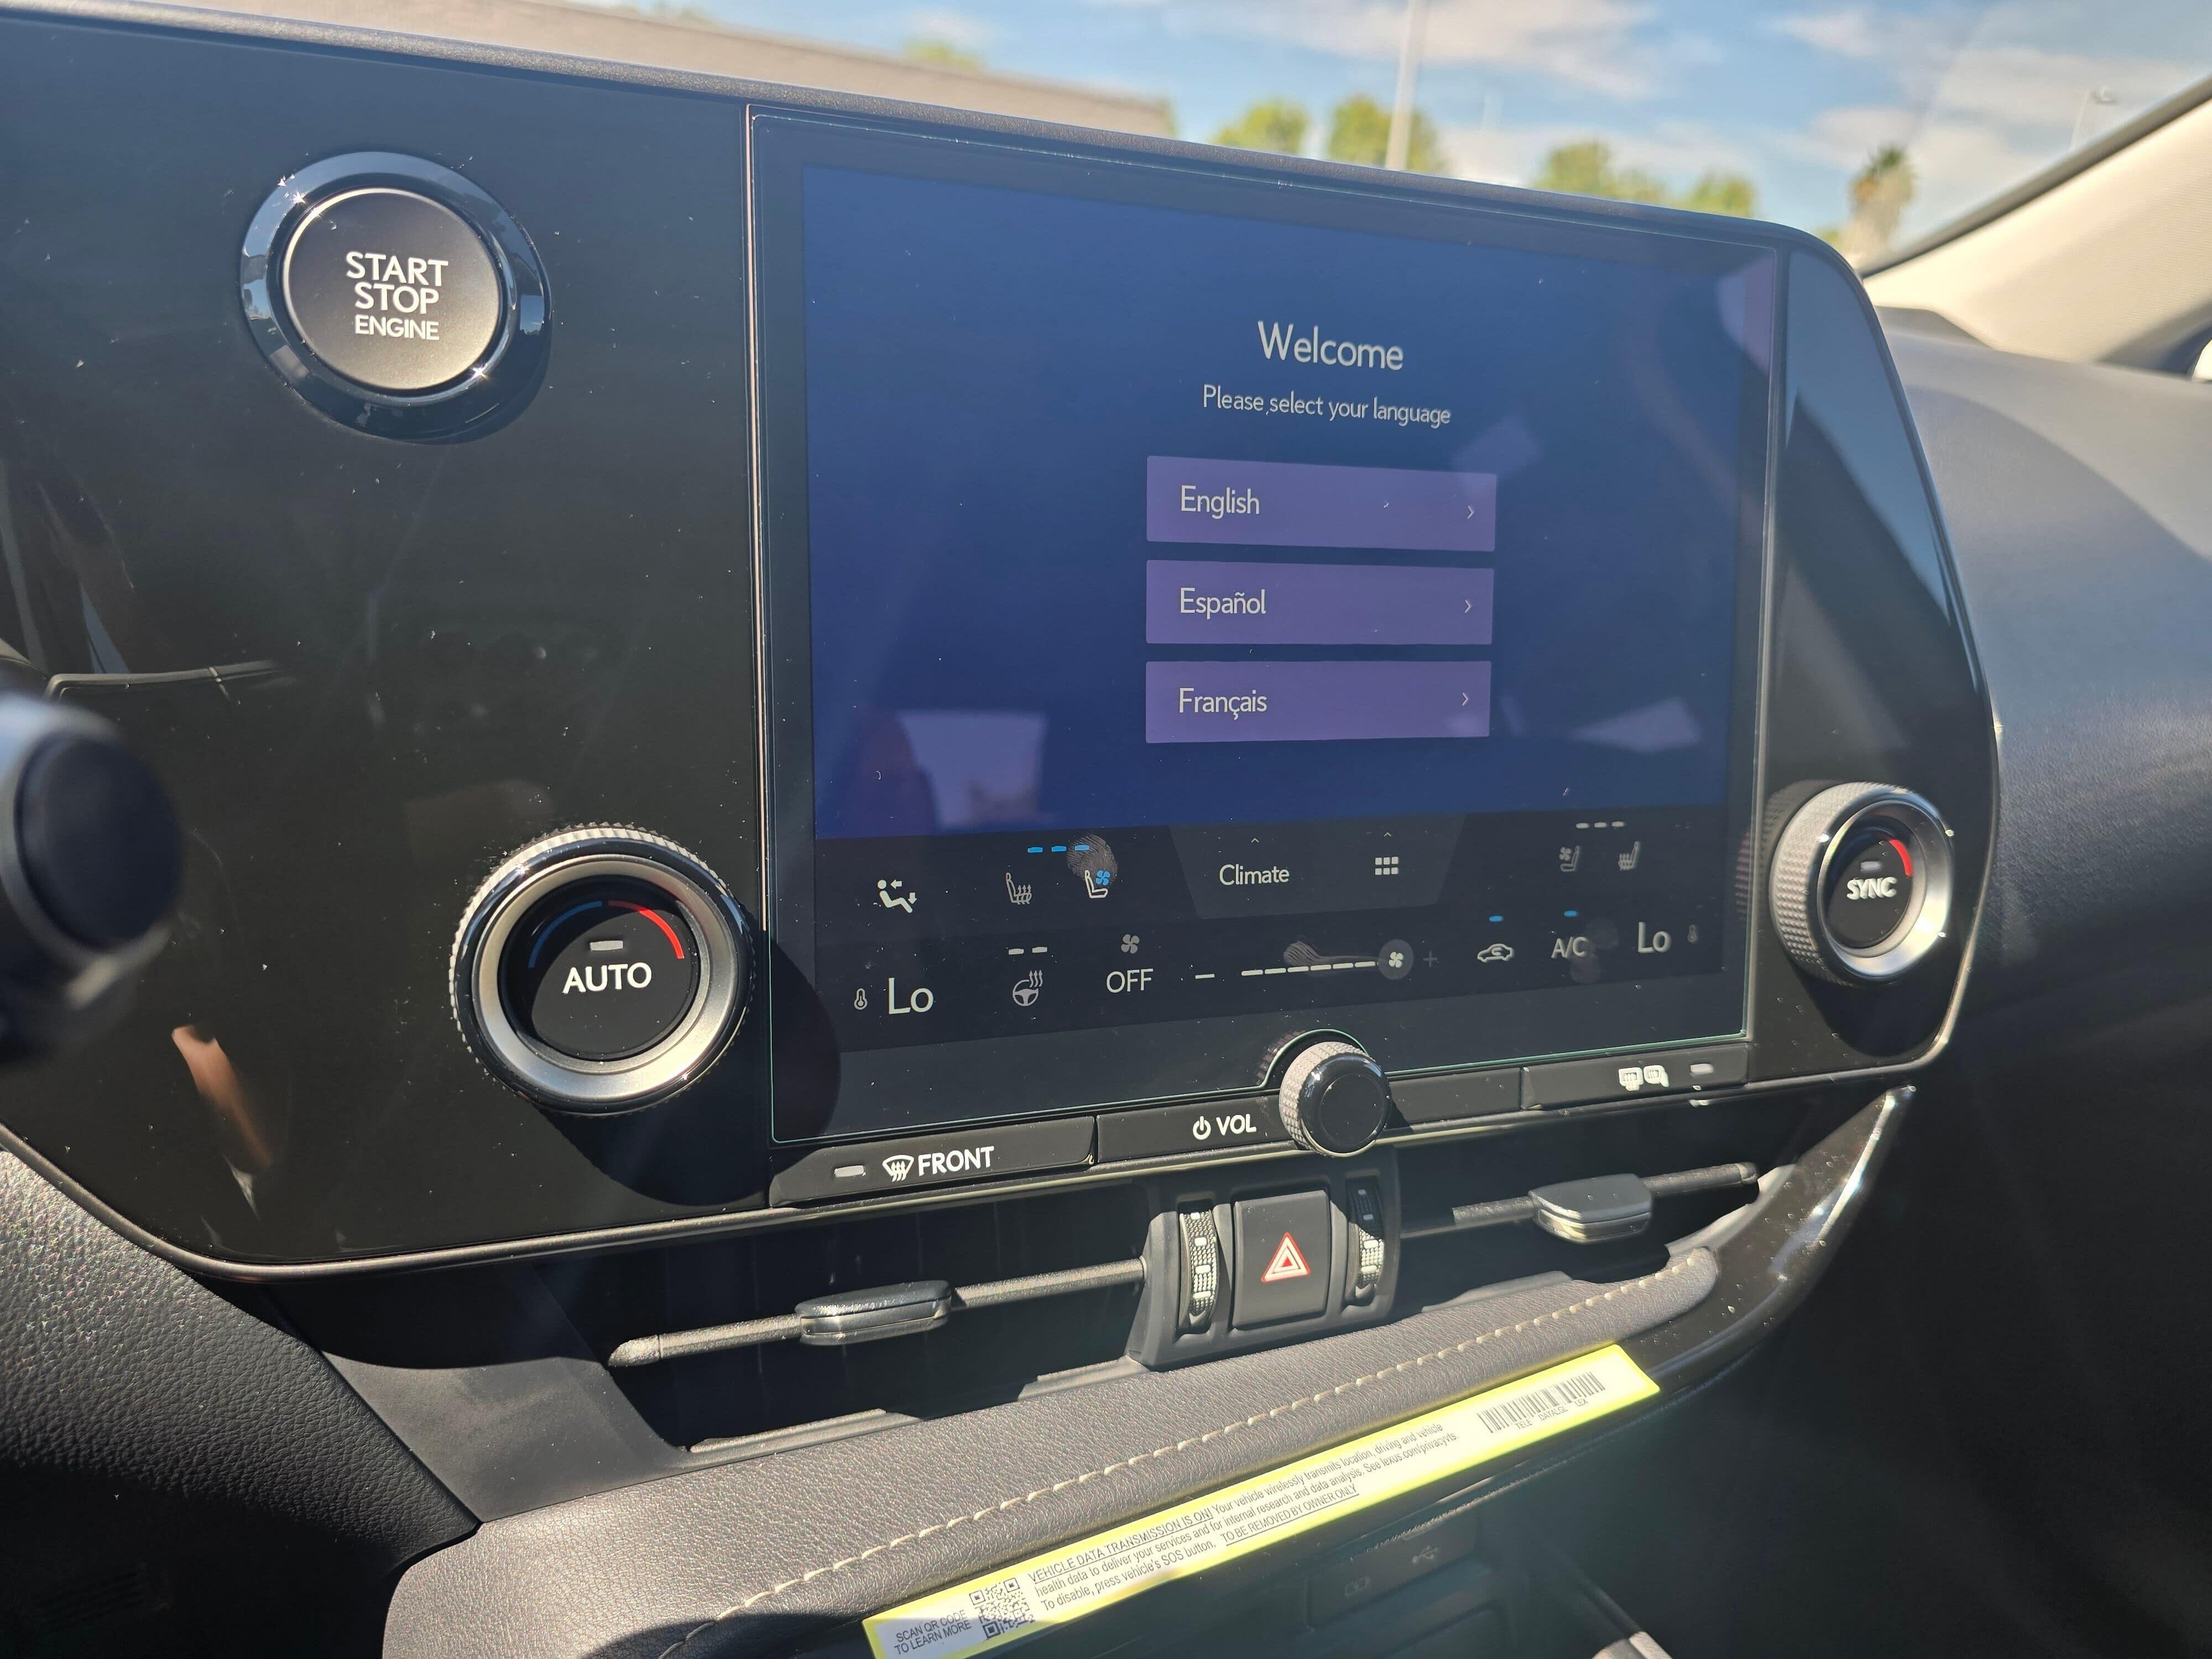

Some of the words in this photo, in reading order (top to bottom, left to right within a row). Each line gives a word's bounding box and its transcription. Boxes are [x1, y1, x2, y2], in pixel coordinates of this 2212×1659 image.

[346, 251, 449, 287] START
[354, 281, 440, 315] STOP
[355, 314, 440, 341] ENGINE
[1258, 321, 1404, 371] Welcome
[1203, 384, 1264, 411] Please
[1269, 390, 1323, 415] select
[1328, 401, 1369, 421] your
[1373, 396, 1451, 429] language
[1181, 485, 1260, 519] English
[1180, 587, 1266, 620] Español
[1179, 687, 1267, 721] Français
[1219, 863, 1290, 885] Climate
[1846, 877, 1896, 900] SYNC
[1551, 936, 1588, 958] A/C
[1637, 921, 1670, 953] Lo
[562, 962, 652, 994] AUTO
[1106, 968, 1154, 993] OFF
[888, 977, 934, 1015] Lo
[1215, 1113, 1257, 1136] VOL
[917, 1145, 994, 1176] FRONT
[1574, 1396, 1589, 1407] LEX
[1027, 1557, 1076, 1582] VEHICLE
[1076, 1548, 1105, 1566] DATA
[1104, 1519, 1182, 1554] TRANSMISSION
[1181, 1515, 1193, 1526] IS
[1211, 1501, 1234, 1514] Your
[1233, 1490, 1264, 1507] vehicle
[1264, 1474, 1305, 1496] wirelessly
[1303, 1461, 1342, 1480] transmits
[1339, 1451, 1376, 1467] location,
[1375, 1439, 1402, 1454] driving
[1401, 1432, 1417, 1444] and
[1416, 1423, 1443, 1438] vehicle
[1220, 1531, 1235, 1542] TO
[1234, 1525, 1249, 1538] BE
[1247, 1510, 1291, 1533] REMOVED
[1290, 1504, 1303, 1516] BY
[1302, 1492, 1337, 1511] OWNER
[1334, 1483, 1357, 1499] ONLY
[1034, 1578, 1067, 1598] health
[1067, 1571, 1089, 1585] data
[1088, 1567, 1100, 1577] to
[1102, 1554, 1132, 1572] deliver
[1133, 1547, 1154, 1563] your
[1155, 1533, 1192, 1552] services
[1192, 1523, 1211, 1538] and
[1209, 1520, 1223, 1531] for
[1222, 1506, 1256, 1526] internal
[1256, 1494, 1293, 1515] research
[1293, 1485, 1311, 1500] and
[1310, 1481, 1329, 1493] data
[1363, 1462, 1381, 1473] See
[1040, 1599, 1055, 1611] To
[1056, 1586, 1095, 1605] disable,
[1094, 1575, 1121, 1594] press
[1121, 1559, 1161, 1581] vehicle's
[1161, 1550, 1184, 1566] SOS
[1183, 1541, 1216, 1557] button.
[894, 1642, 910, 1655] TO
[910, 1630, 943, 1650] LEARN
[942, 1620, 972, 1638] MORE
[896, 1625, 924, 1642] SCAN
[924, 1620, 940, 1632] QR
[940, 1609, 966, 1627] CODE
